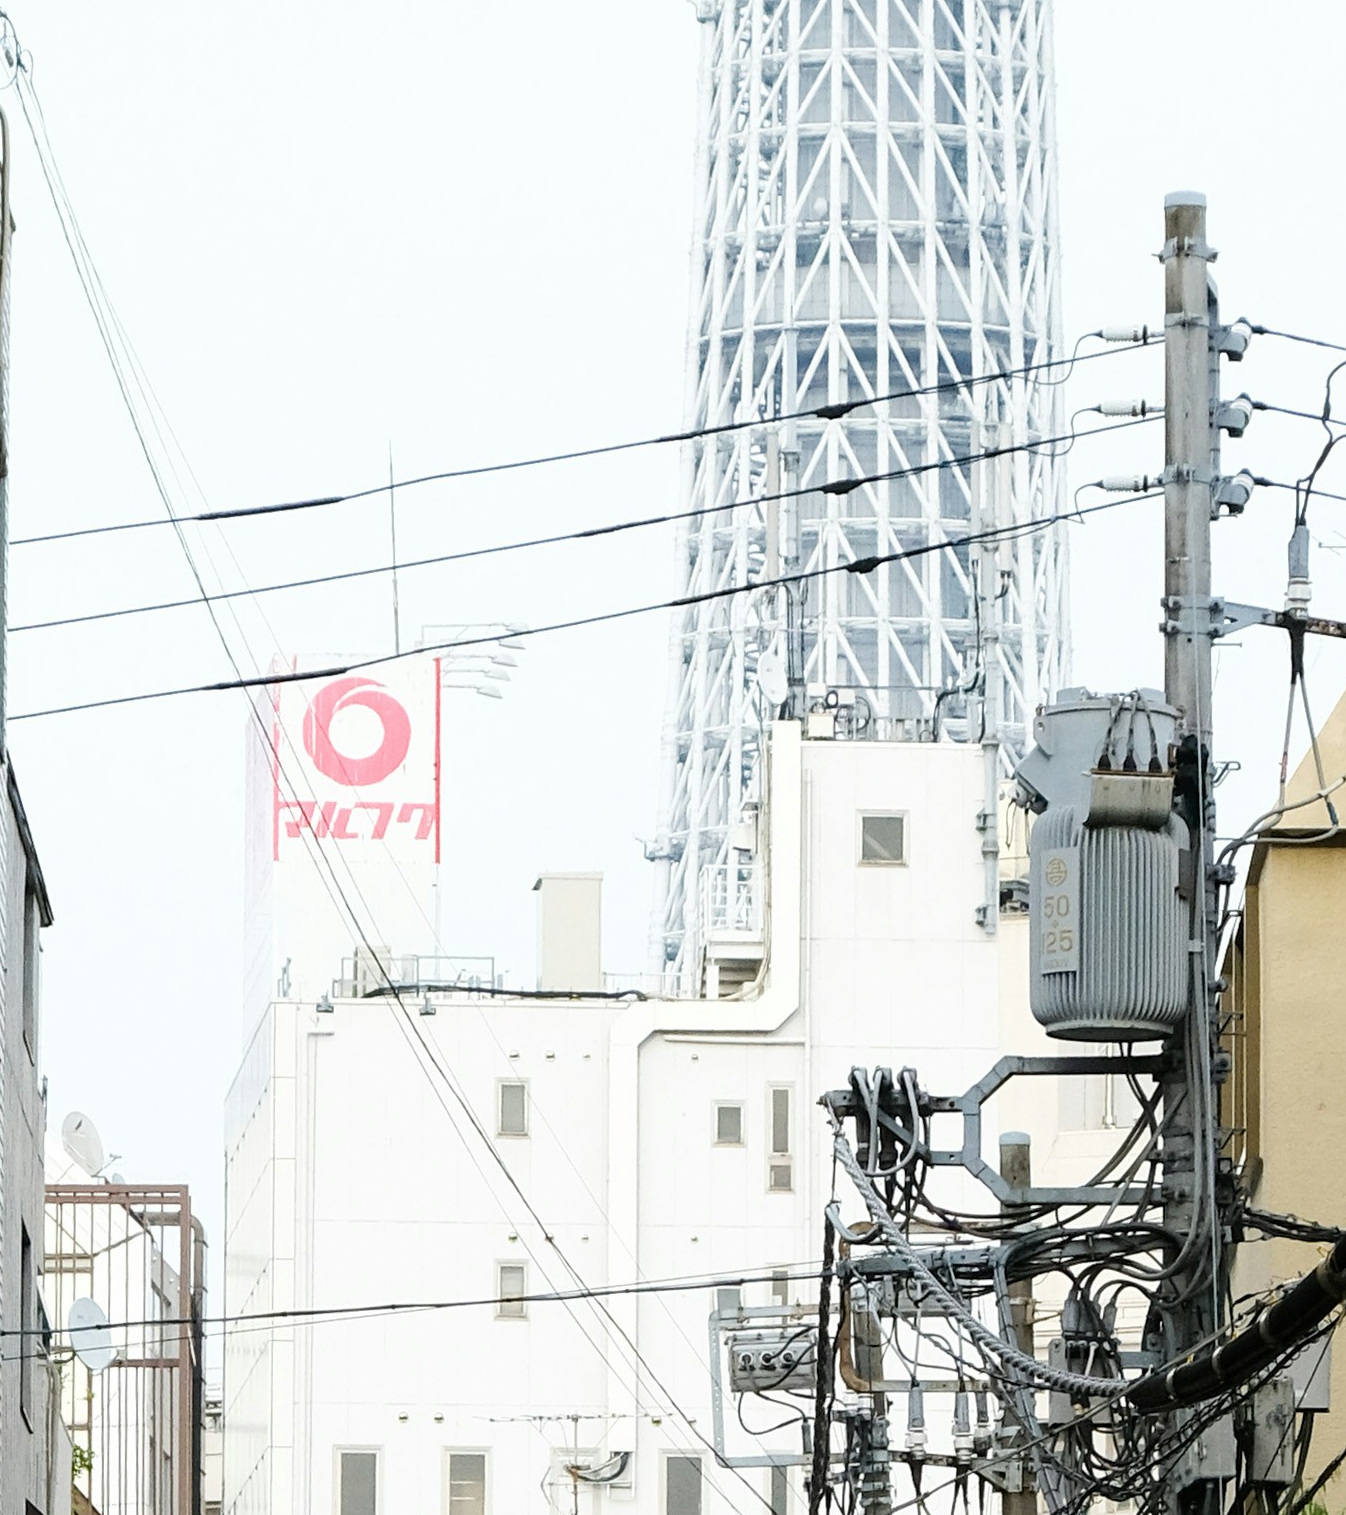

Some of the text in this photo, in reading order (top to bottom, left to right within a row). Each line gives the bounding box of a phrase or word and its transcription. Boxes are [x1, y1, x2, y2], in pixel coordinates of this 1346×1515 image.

[279, 801, 437, 840] マルフク
[1044, 895, 1070, 919] 50
